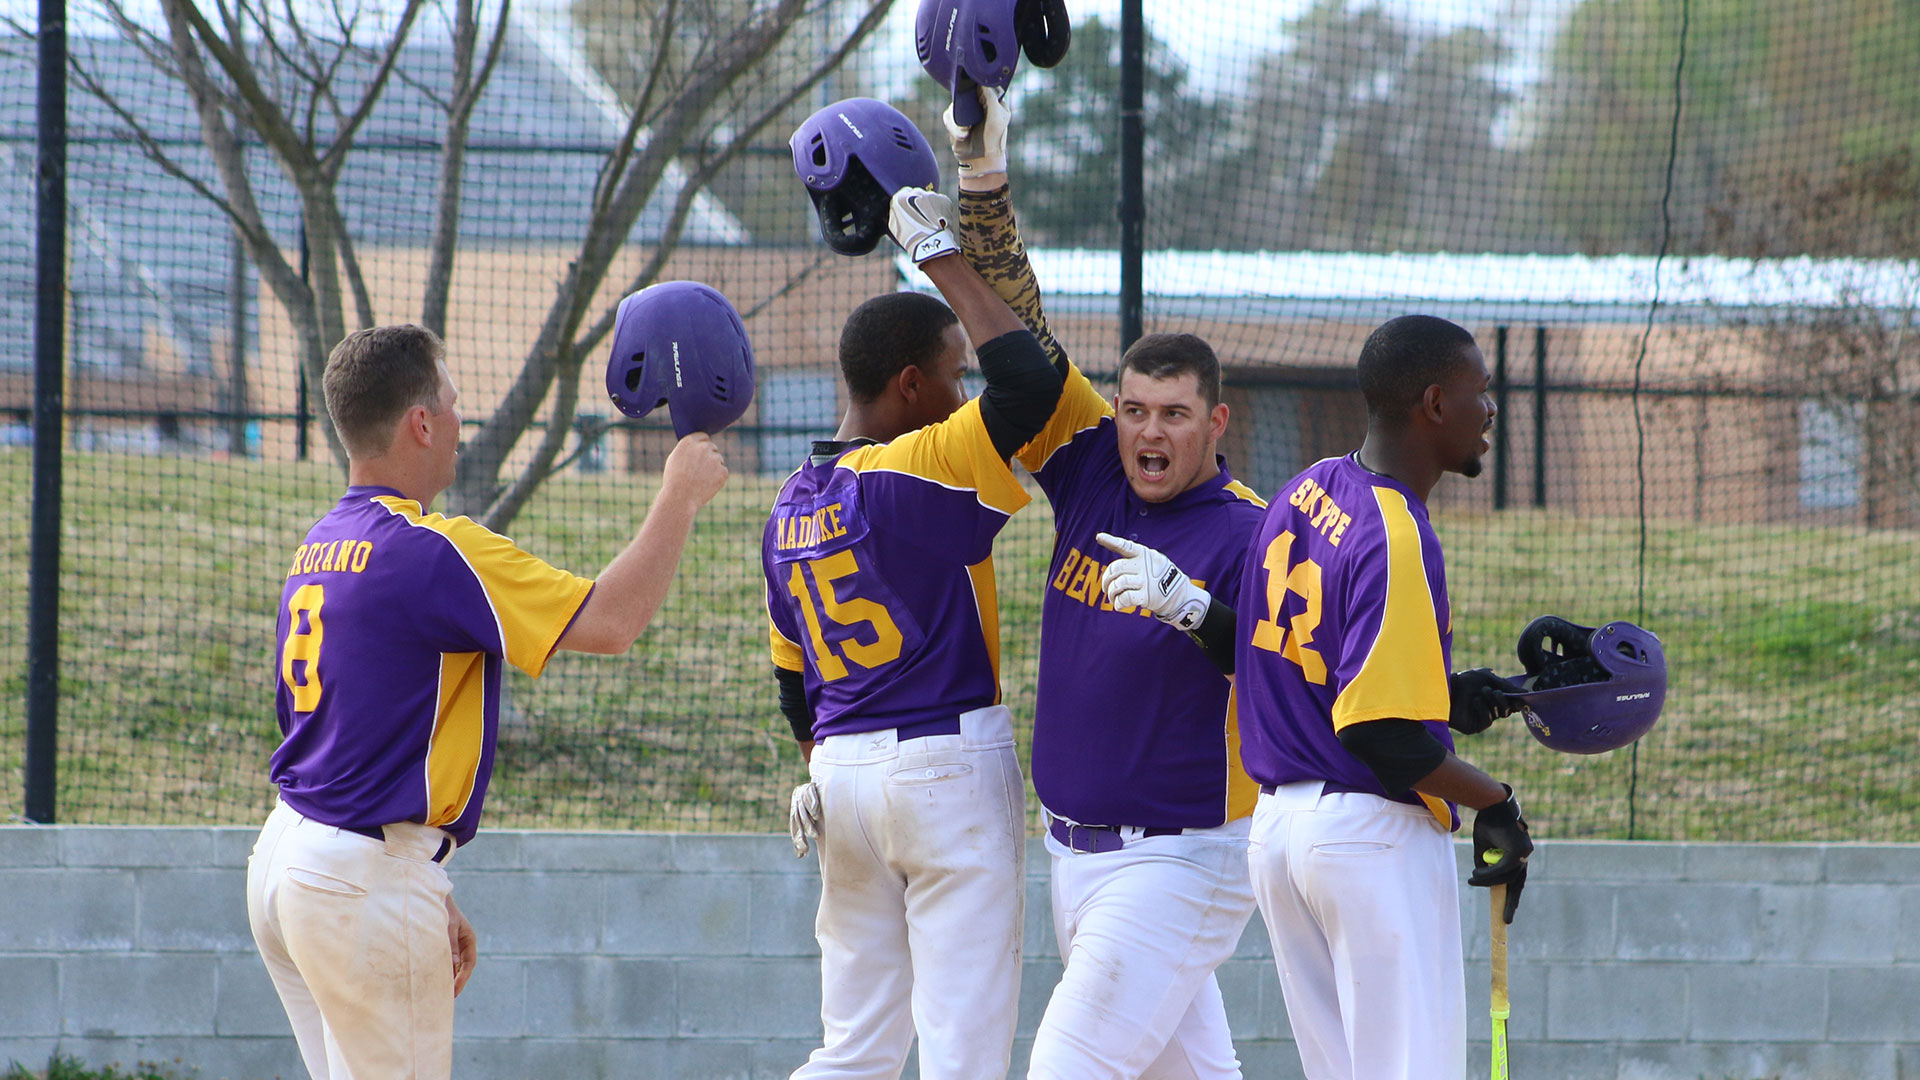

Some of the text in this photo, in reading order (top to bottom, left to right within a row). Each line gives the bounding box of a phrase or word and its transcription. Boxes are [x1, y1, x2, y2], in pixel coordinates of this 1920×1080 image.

[286, 539, 373, 579] ROIANO
[1289, 477, 1352, 547] SKYPE
[281, 584, 325, 712] 8
[787, 548, 904, 682] 15
